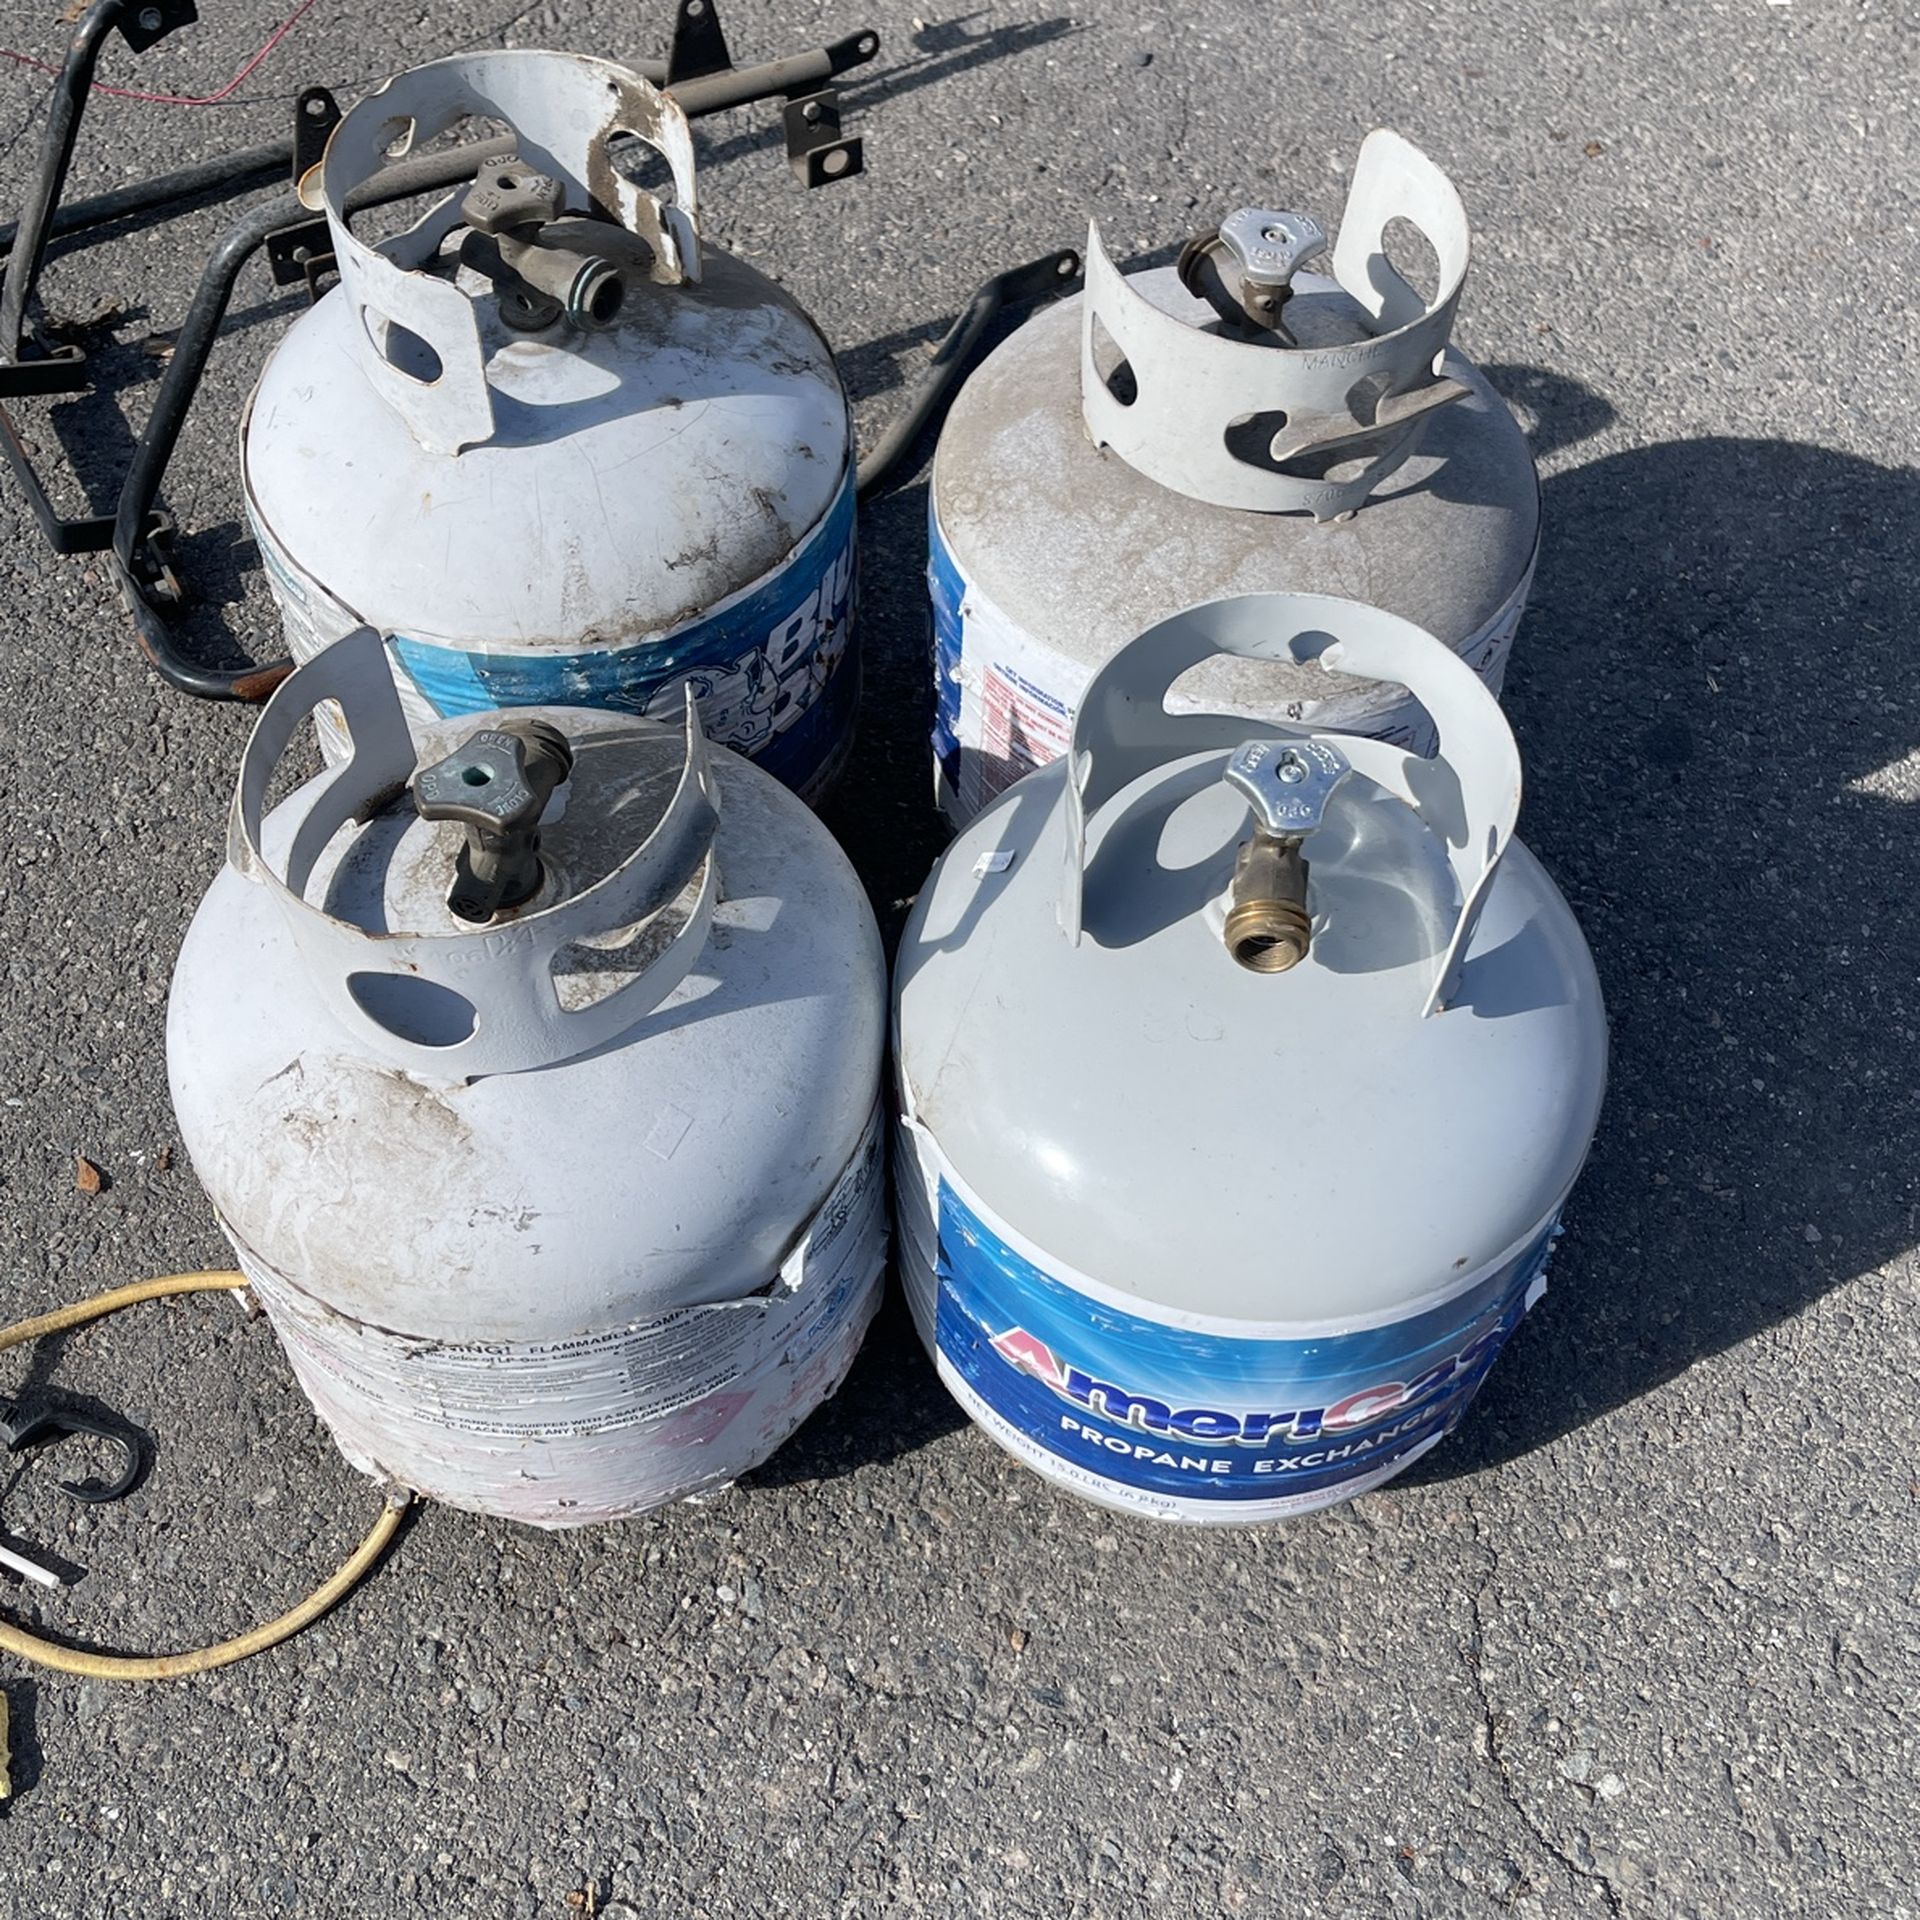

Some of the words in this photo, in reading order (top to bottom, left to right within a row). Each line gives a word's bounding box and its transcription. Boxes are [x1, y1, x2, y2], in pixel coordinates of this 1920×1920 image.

[593, 1343, 622, 1355] may
[571, 1416, 602, 1426] WITH
[615, 1400, 661, 1418] SAFETY
[545, 1427, 569, 1436] ANY
[1060, 1414, 1233, 1475] PROPANE
[1252, 1404, 1437, 1475] EXCHANGE
